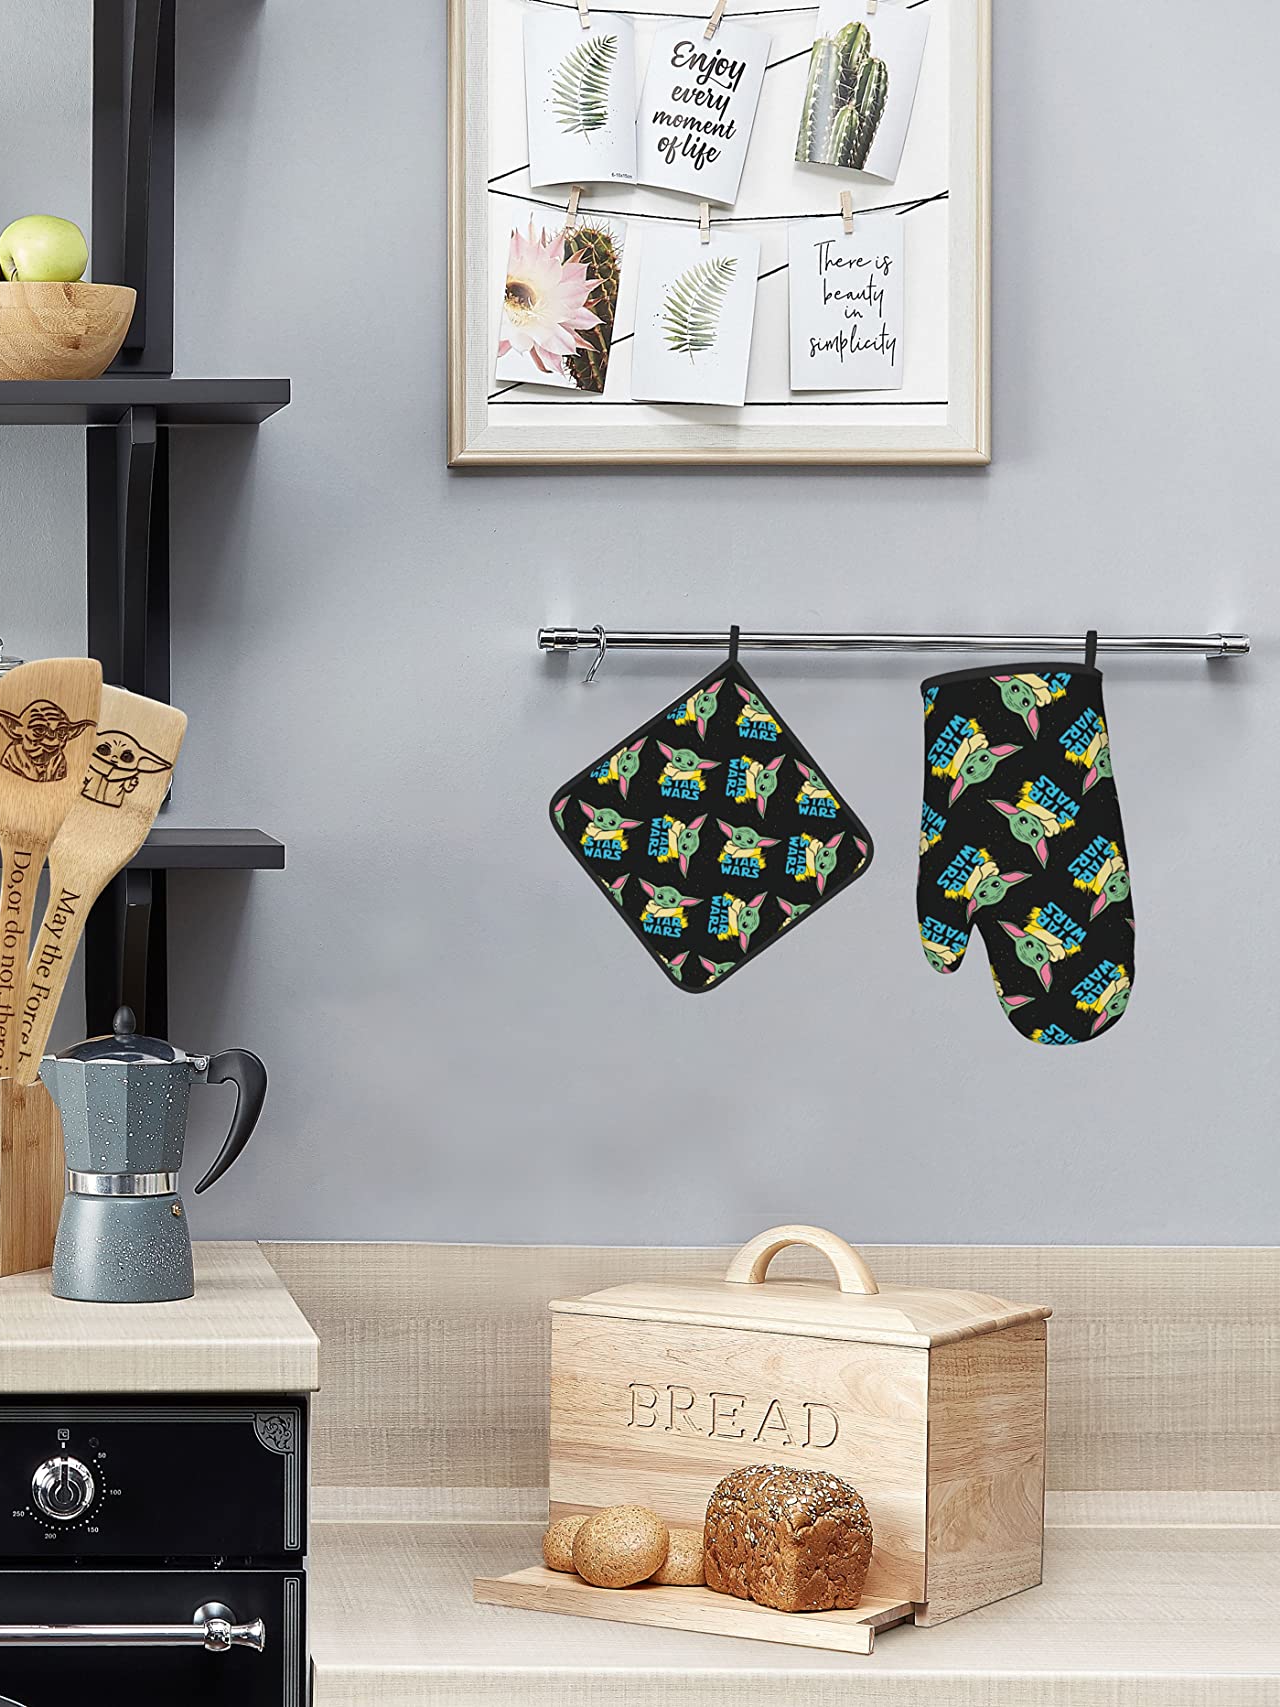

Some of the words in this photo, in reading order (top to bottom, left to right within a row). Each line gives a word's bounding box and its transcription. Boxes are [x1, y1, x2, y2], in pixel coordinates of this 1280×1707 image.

[670, 40, 746, 92] Enjoy
[671, 85, 731, 121] every
[652, 111, 737, 140] moment
[657, 136, 682, 164] of
[681, 133, 721, 170] life
[813, 240, 872, 275] There
[875, 255, 893, 276] is
[823, 273, 884, 318] beauty
[844, 305, 863, 318] in
[810, 322, 897, 366] simplicity
[738, 727, 777, 742] WARS
[739, 717, 776, 733] STAR
[927, 714, 966, 764] WARS
[1058, 707, 1097, 749] WARS
[1069, 718, 1102, 756] STAR
[934, 721, 974, 768] STAR
[660, 785, 700, 801] WARS
[662, 776, 700, 791] STAR
[725, 758, 740, 797] WARS
[735, 759, 749, 797] STAR
[1034, 774, 1080, 817] WARS
[798, 805, 837, 819] WARS
[799, 794, 835, 809] STAR
[1029, 784, 1072, 824] STAR
[583, 847, 622, 861] WARS
[584, 836, 622, 851] STAR
[647, 817, 662, 856] WARS
[657, 819, 672, 856] STAR
[785, 835, 799, 875] WARS
[720, 864, 759, 879] WARS
[722, 854, 760, 869] STAR
[795, 837, 809, 875] STAR
[936, 845, 976, 889] WARS
[947, 851, 984, 891] STAR
[1067, 835, 1108, 877] WARS
[1077, 843, 1115, 883] STAR
[44, 887, 82, 940] May
[642, 923, 681, 938] WARS
[643, 913, 681, 928] STAR
[707, 895, 722, 934] WARS
[717, 897, 732, 934] STAR
[923, 915, 969, 945] WARS
[1036, 910, 1078, 949] STAR
[1042, 901, 1087, 943] WARS
[3, 920, 25, 948] do
[921, 925, 965, 953] STAR
[36, 943, 63, 978] the
[1071, 959, 1115, 999] WARS
[1080, 967, 1121, 1004] STAR
[21, 982, 51, 1045] Force
[627, 1383, 840, 1448] BREAD
